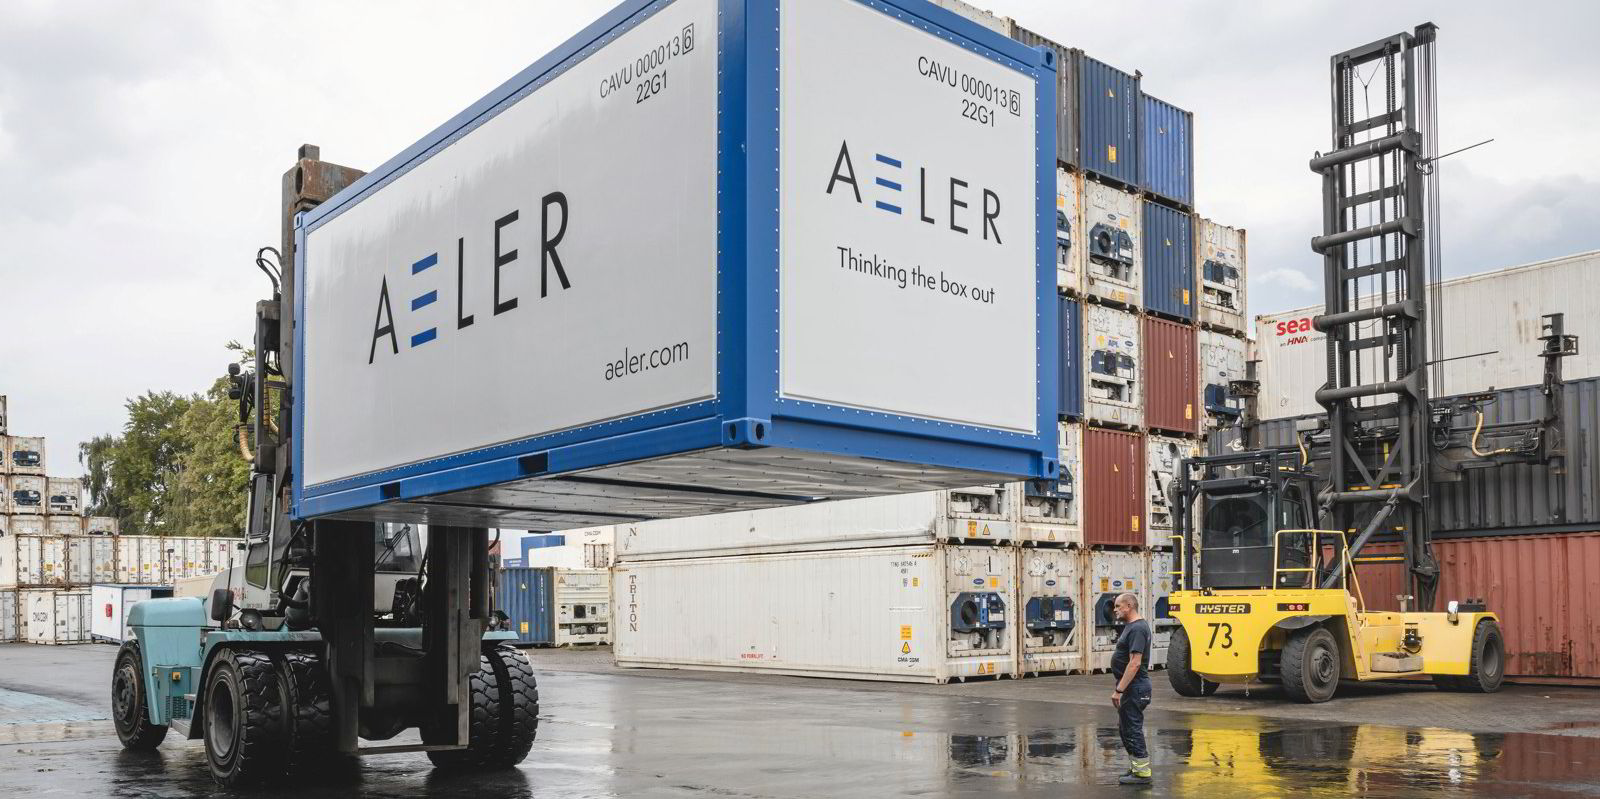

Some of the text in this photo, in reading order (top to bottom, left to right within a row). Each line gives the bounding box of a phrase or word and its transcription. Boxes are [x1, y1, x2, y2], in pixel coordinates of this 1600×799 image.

[600, 64, 632, 98] CAVU
[636, 70, 667, 104] 22G1
[918, 56, 957, 87] CAVU
[962, 99, 994, 127] 22G1
[826, 139, 1002, 244] AELER
[369, 191, 571, 365] AELER
[837, 246, 995, 304] Thinking the box out
[1276, 317, 1313, 336] sea
[1287, 335, 1308, 346] HNA
[605, 341, 688, 380] aeler.com
[628, 574, 638, 632] TRITON
[1200, 604, 1245, 613] HYSTER
[1208, 622, 1232, 649] 73
